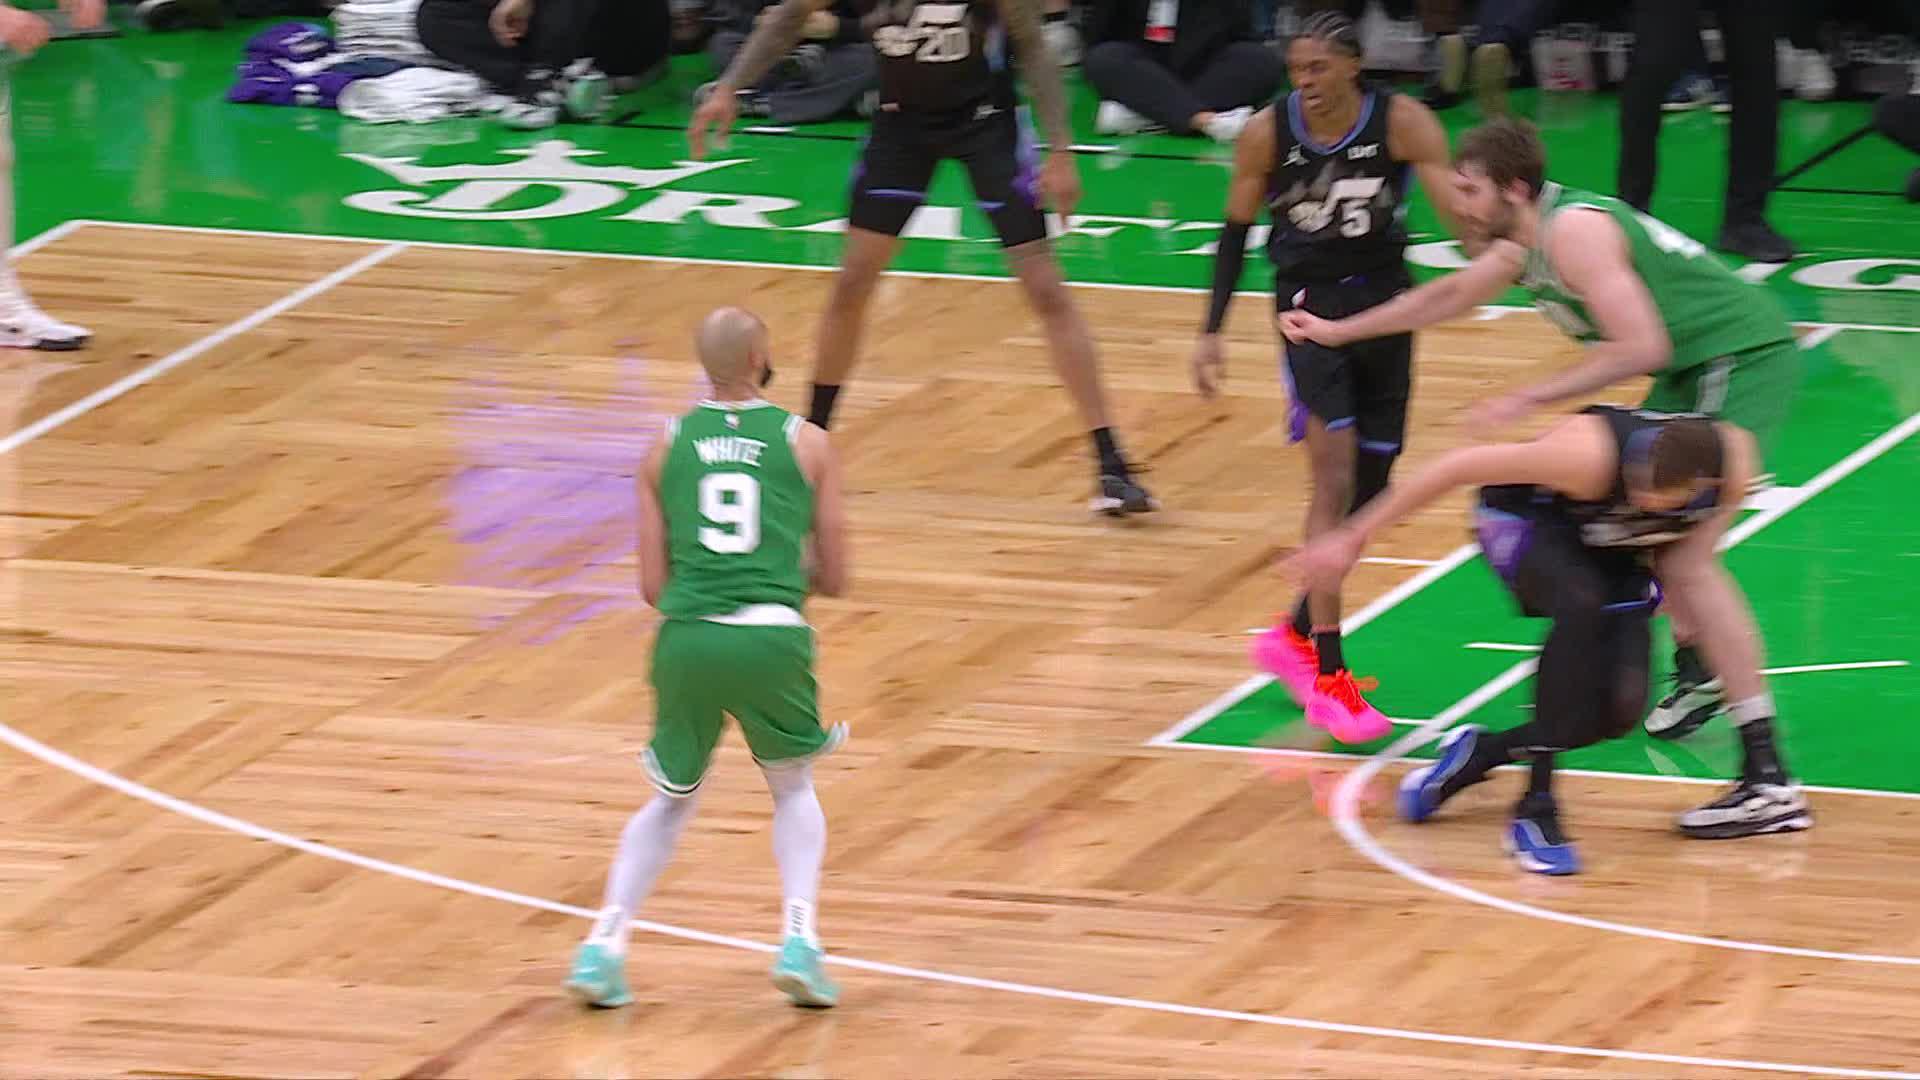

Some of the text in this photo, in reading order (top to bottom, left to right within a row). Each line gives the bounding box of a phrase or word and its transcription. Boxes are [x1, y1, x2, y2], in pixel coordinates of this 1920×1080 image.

[915, 26, 971, 63] 20
[1340, 198, 1371, 238] 5
[692, 436, 768, 467] WHITE
[698, 472, 761, 554] 9
